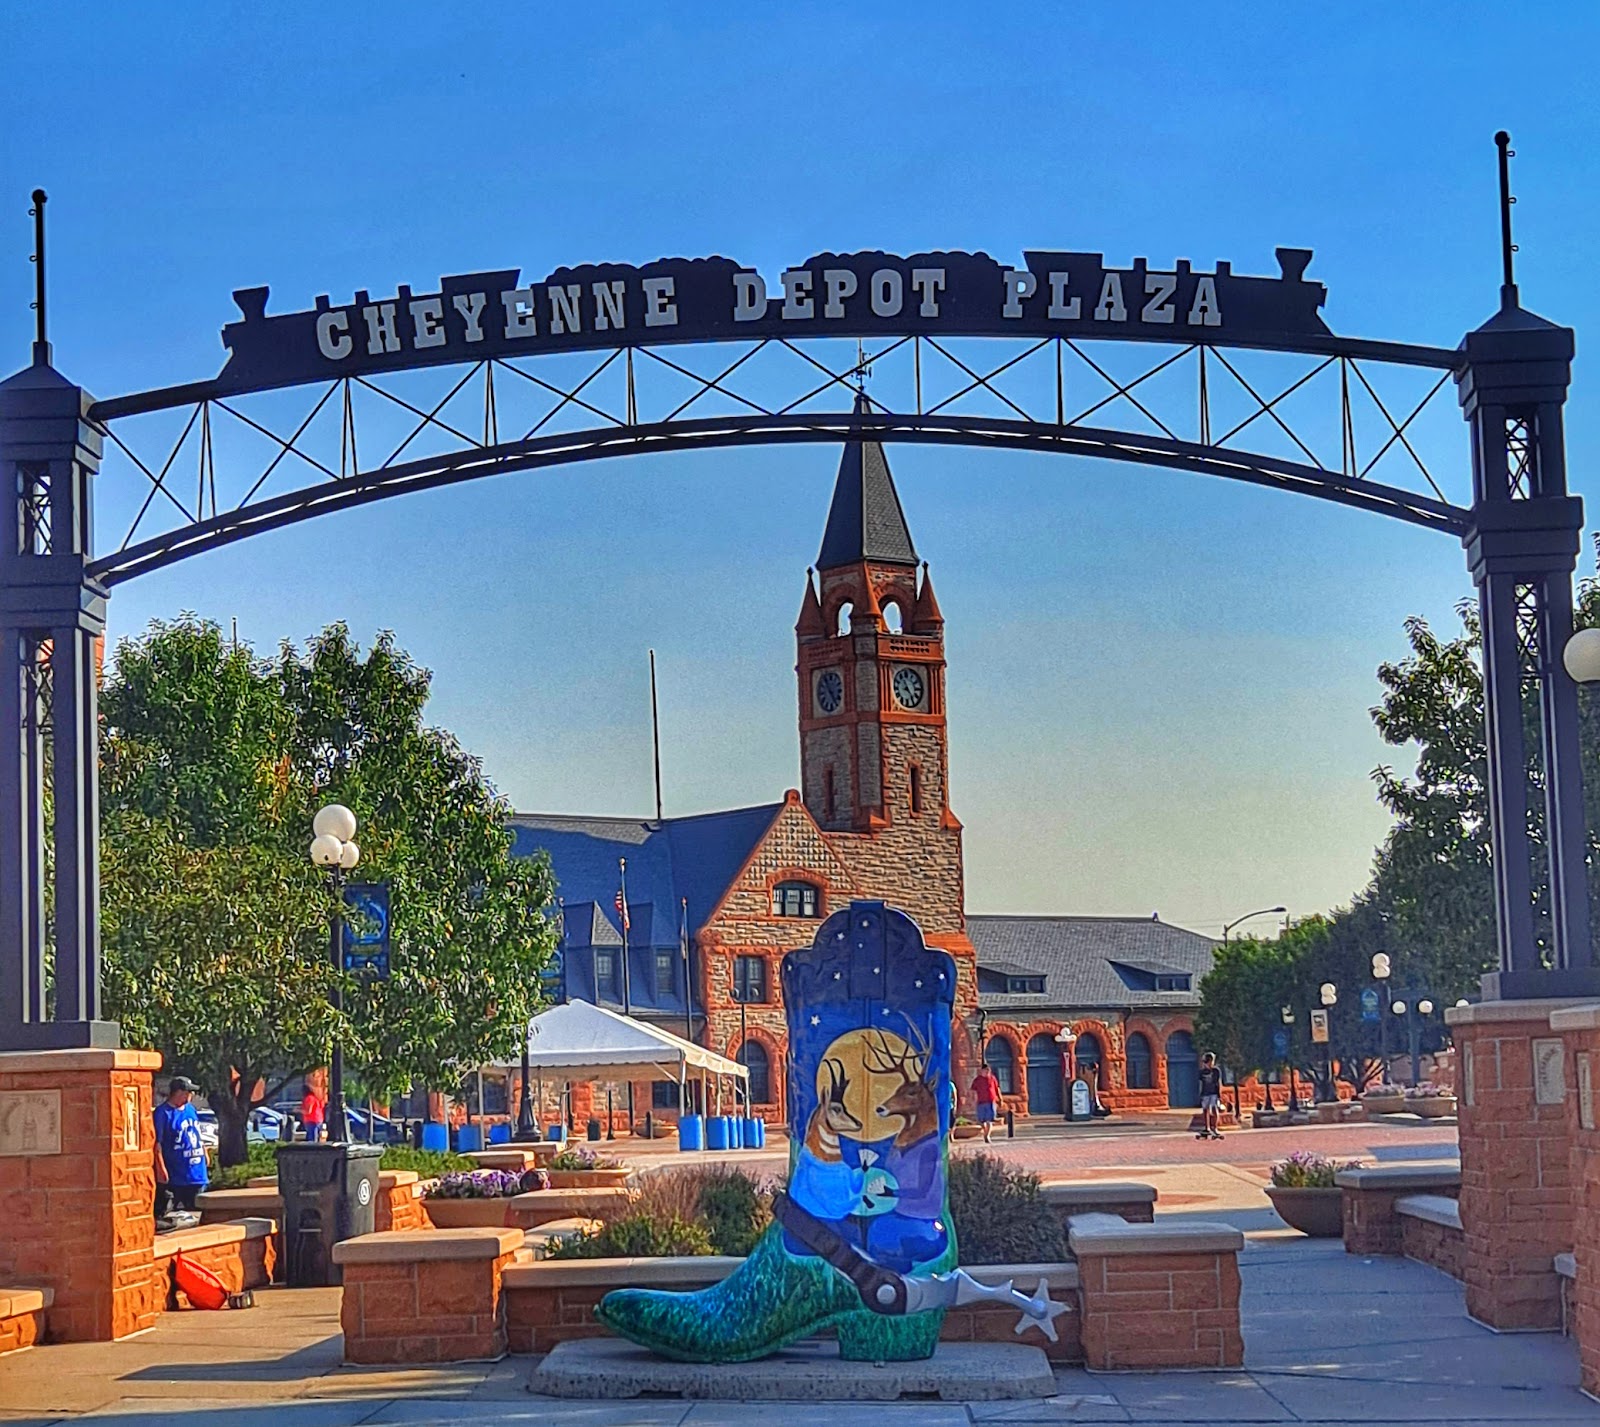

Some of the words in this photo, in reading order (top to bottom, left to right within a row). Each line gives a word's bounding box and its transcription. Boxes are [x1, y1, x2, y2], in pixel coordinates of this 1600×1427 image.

[316, 276, 679, 361] CHEYENNE
[733, 269, 946, 322] DEPOT
[1003, 271, 1222, 326] PLAZA
